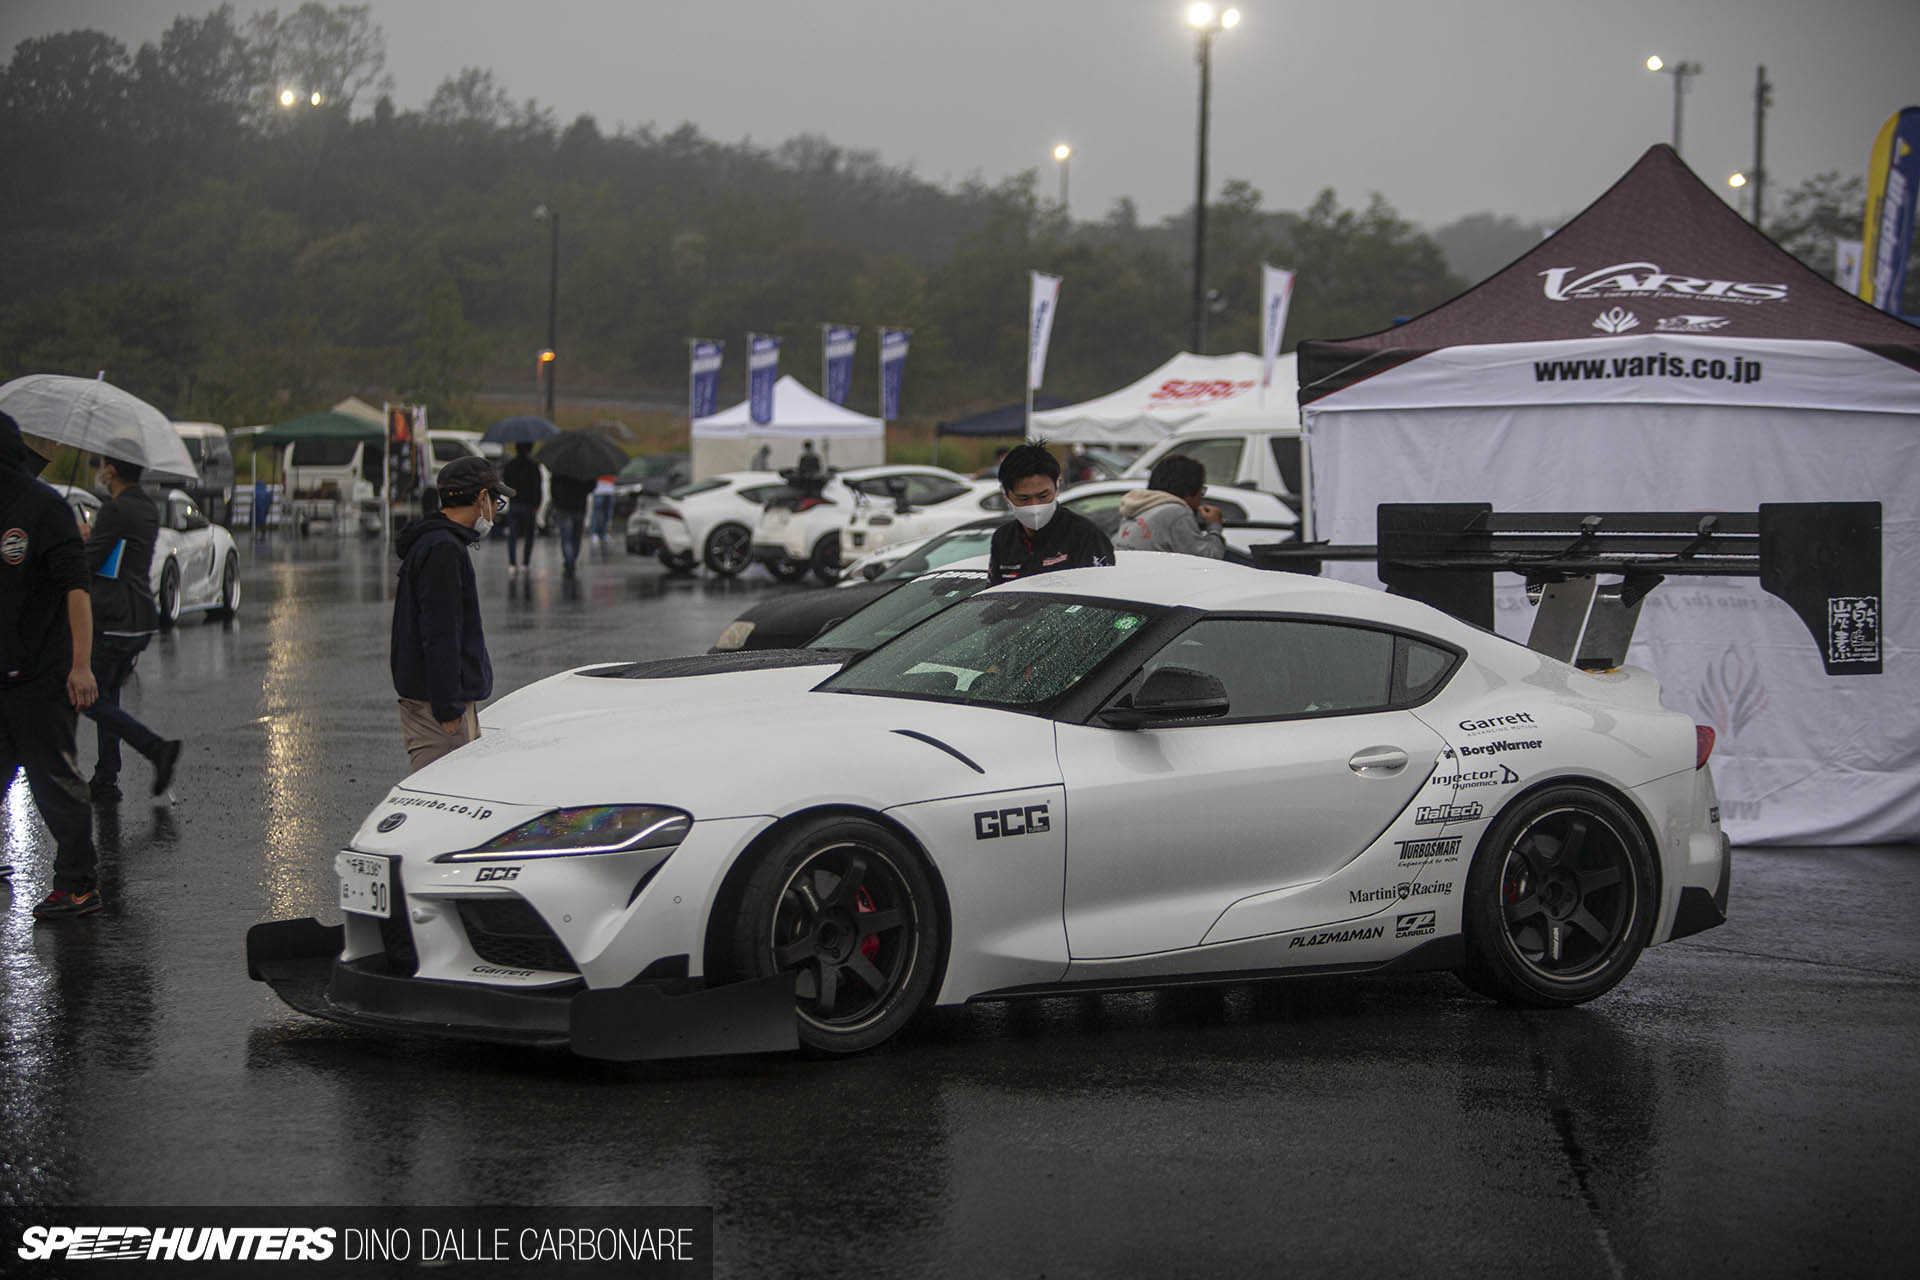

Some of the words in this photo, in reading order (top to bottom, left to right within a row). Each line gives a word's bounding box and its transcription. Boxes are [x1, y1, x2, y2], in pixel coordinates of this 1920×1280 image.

[1538, 262, 1788, 301] VARIS
[1534, 353, 1762, 384] www.varis.co.jp
[1459, 712, 1535, 731] Garrett
[1460, 739, 1543, 757] BorgWarner
[1432, 769, 1498, 786] Injector
[1452, 780, 1498, 791] Dynamics
[1417, 801, 1483, 821] Haltech
[974, 804, 1050, 840] GCG
[1394, 835, 1463, 860] TURBOSMART
[475, 866, 522, 881] GCG
[1350, 886, 1396, 903] Martini
[1411, 881, 1453, 896] Racing
[1289, 926, 1385, 949] PLAZMAMAN
[1395, 928, 1435, 938] CARRILLO
[472, 965, 536, 976] Garrett
